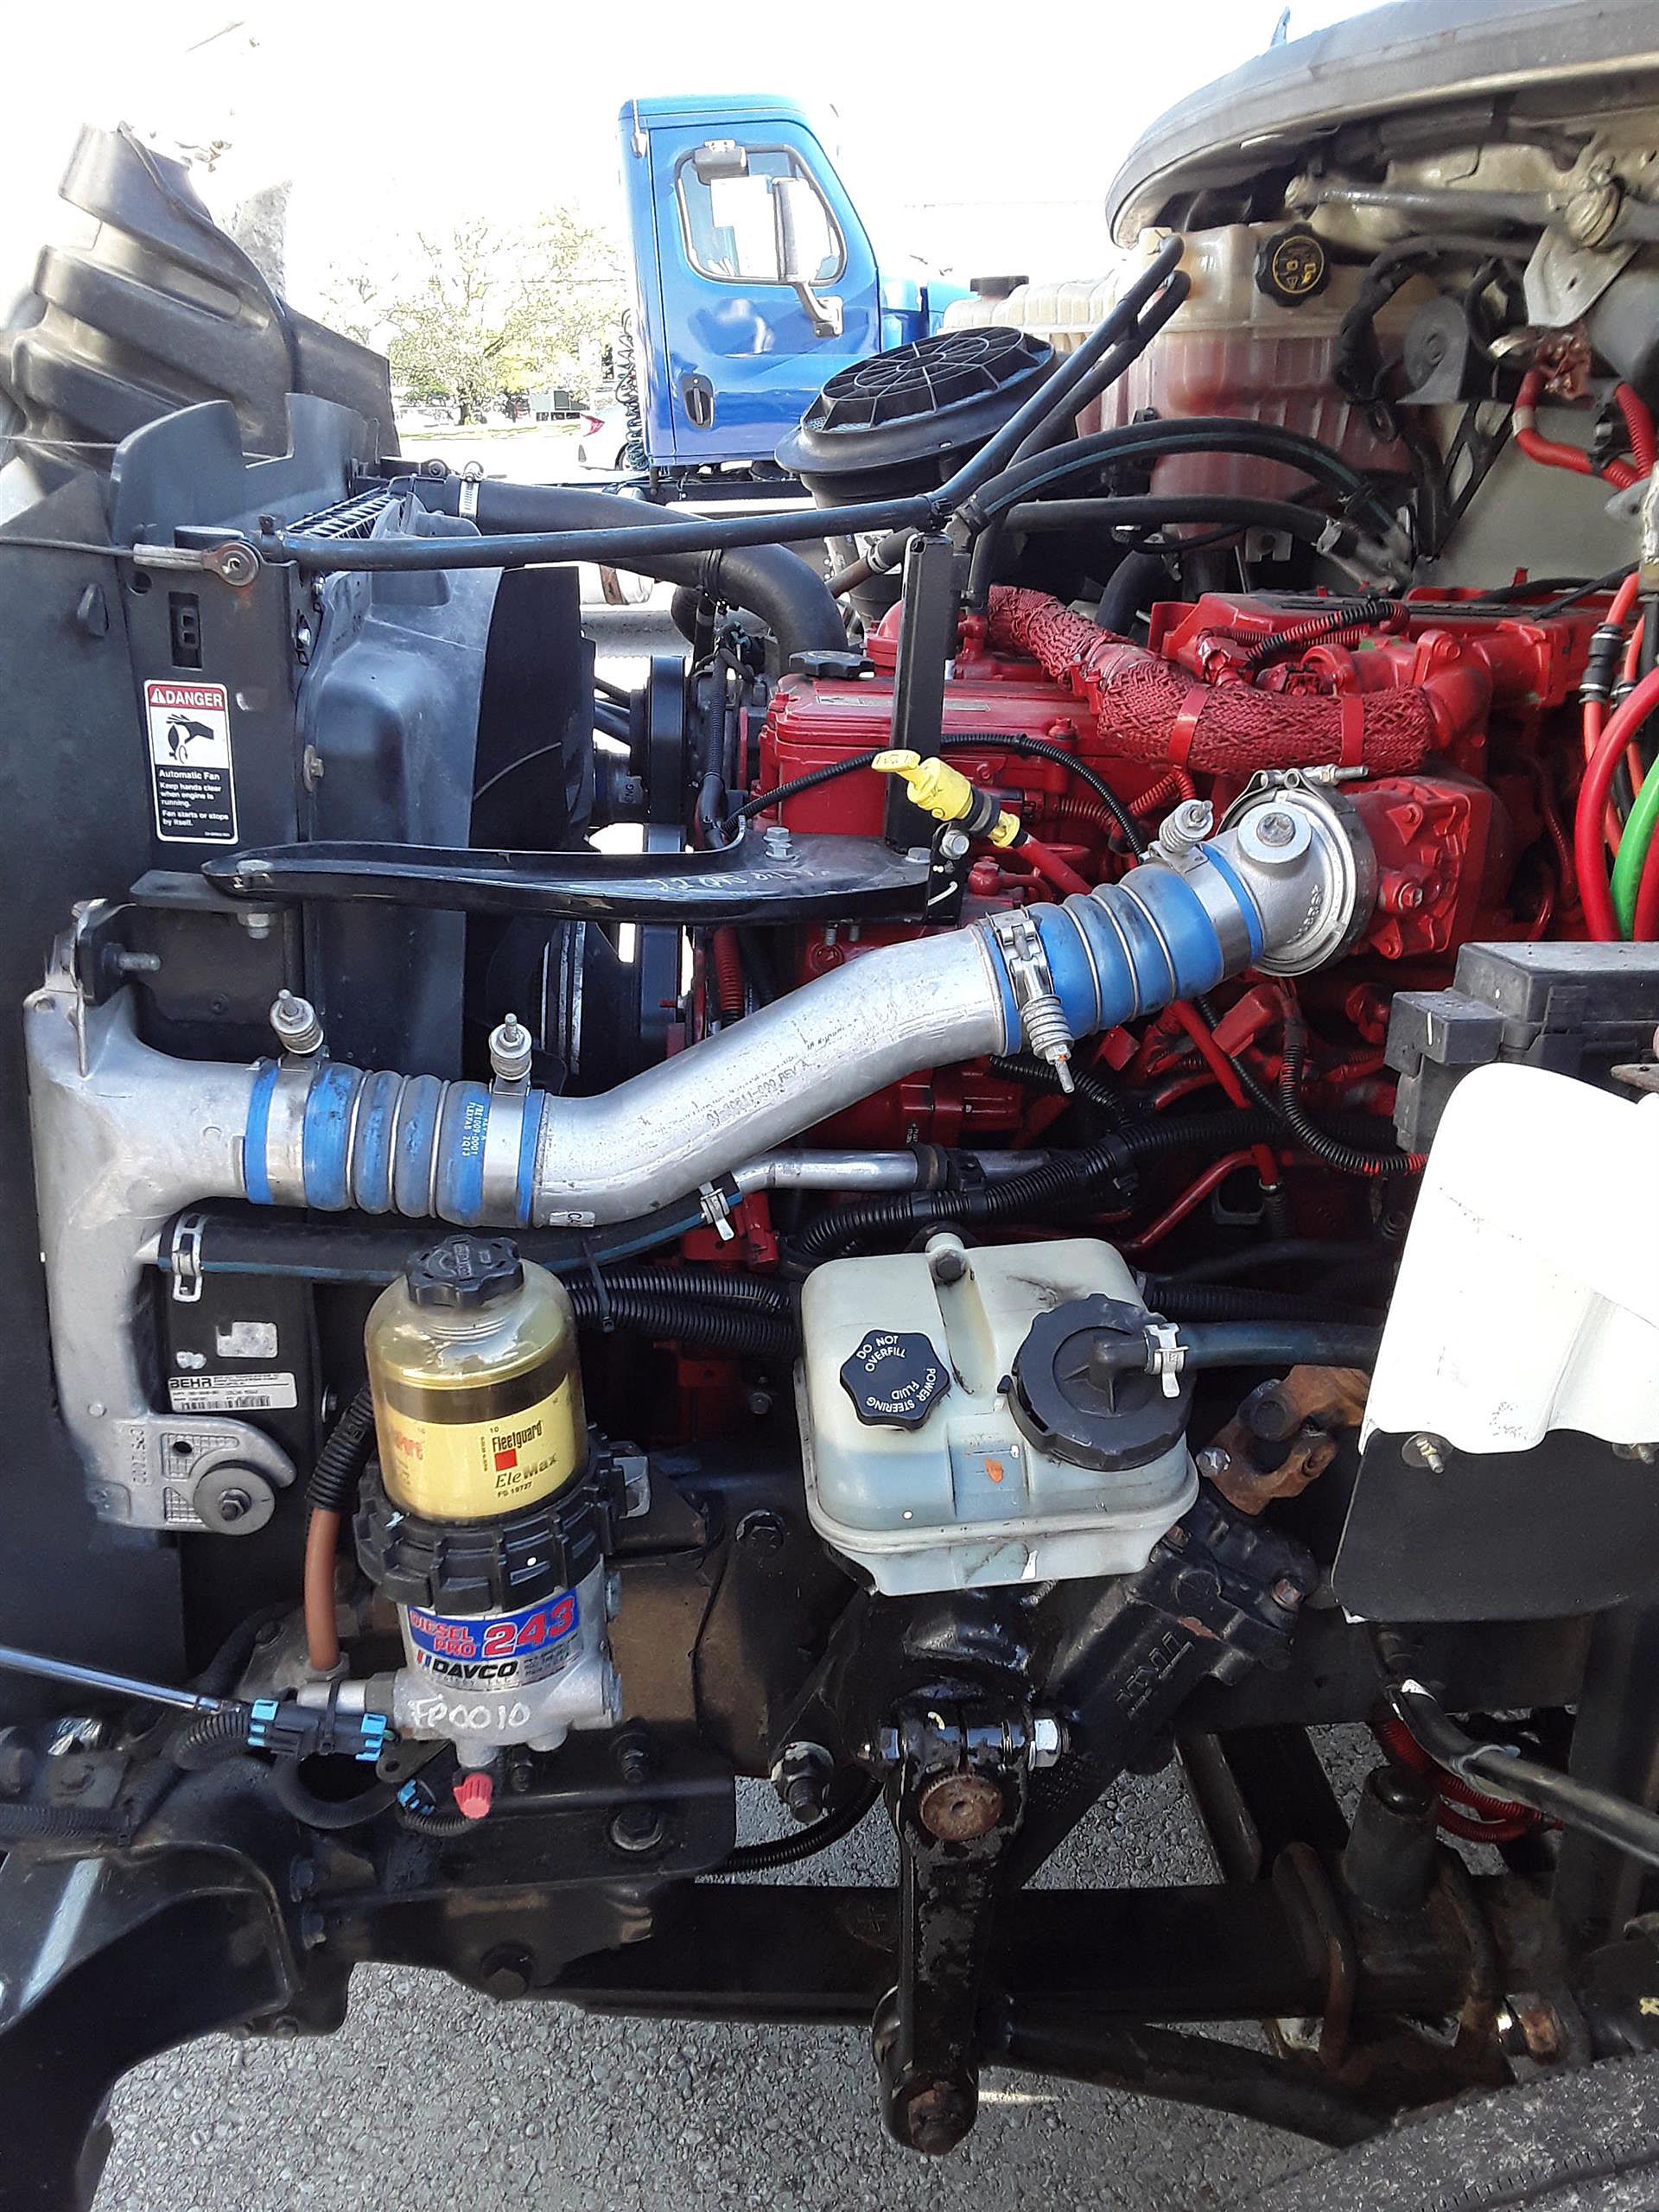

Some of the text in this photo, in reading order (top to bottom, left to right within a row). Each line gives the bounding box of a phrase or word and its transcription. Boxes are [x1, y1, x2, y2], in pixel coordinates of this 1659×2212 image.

[165, 690, 223, 708] DANGER
[159, 768, 220, 781] Automatic Fan
[159, 781, 222, 792] Keep hands clear
[162, 799, 192, 809] running.
[181, 792, 207, 801] engine
[162, 809, 176, 817] Fan
[177, 810, 199, 819] starts
[208, 812, 230, 821] stops
[162, 817, 194, 827] by itself.
[855, 1335, 899, 1360] DO NOT
[865, 1346, 906, 1372] OVERFILL
[169, 1377, 213, 1389] BEHR
[866, 1368, 937, 1413] POWER STEERING
[891, 1380, 920, 1400] FLUID
[492, 1420, 543, 1452] Fleetguard
[511, 1481, 532, 1494] 19727
[410, 1595, 576, 1657] DIESEL 243
[434, 1637, 475, 1658] PRO
[432, 1658, 518, 1680] DAVCO
